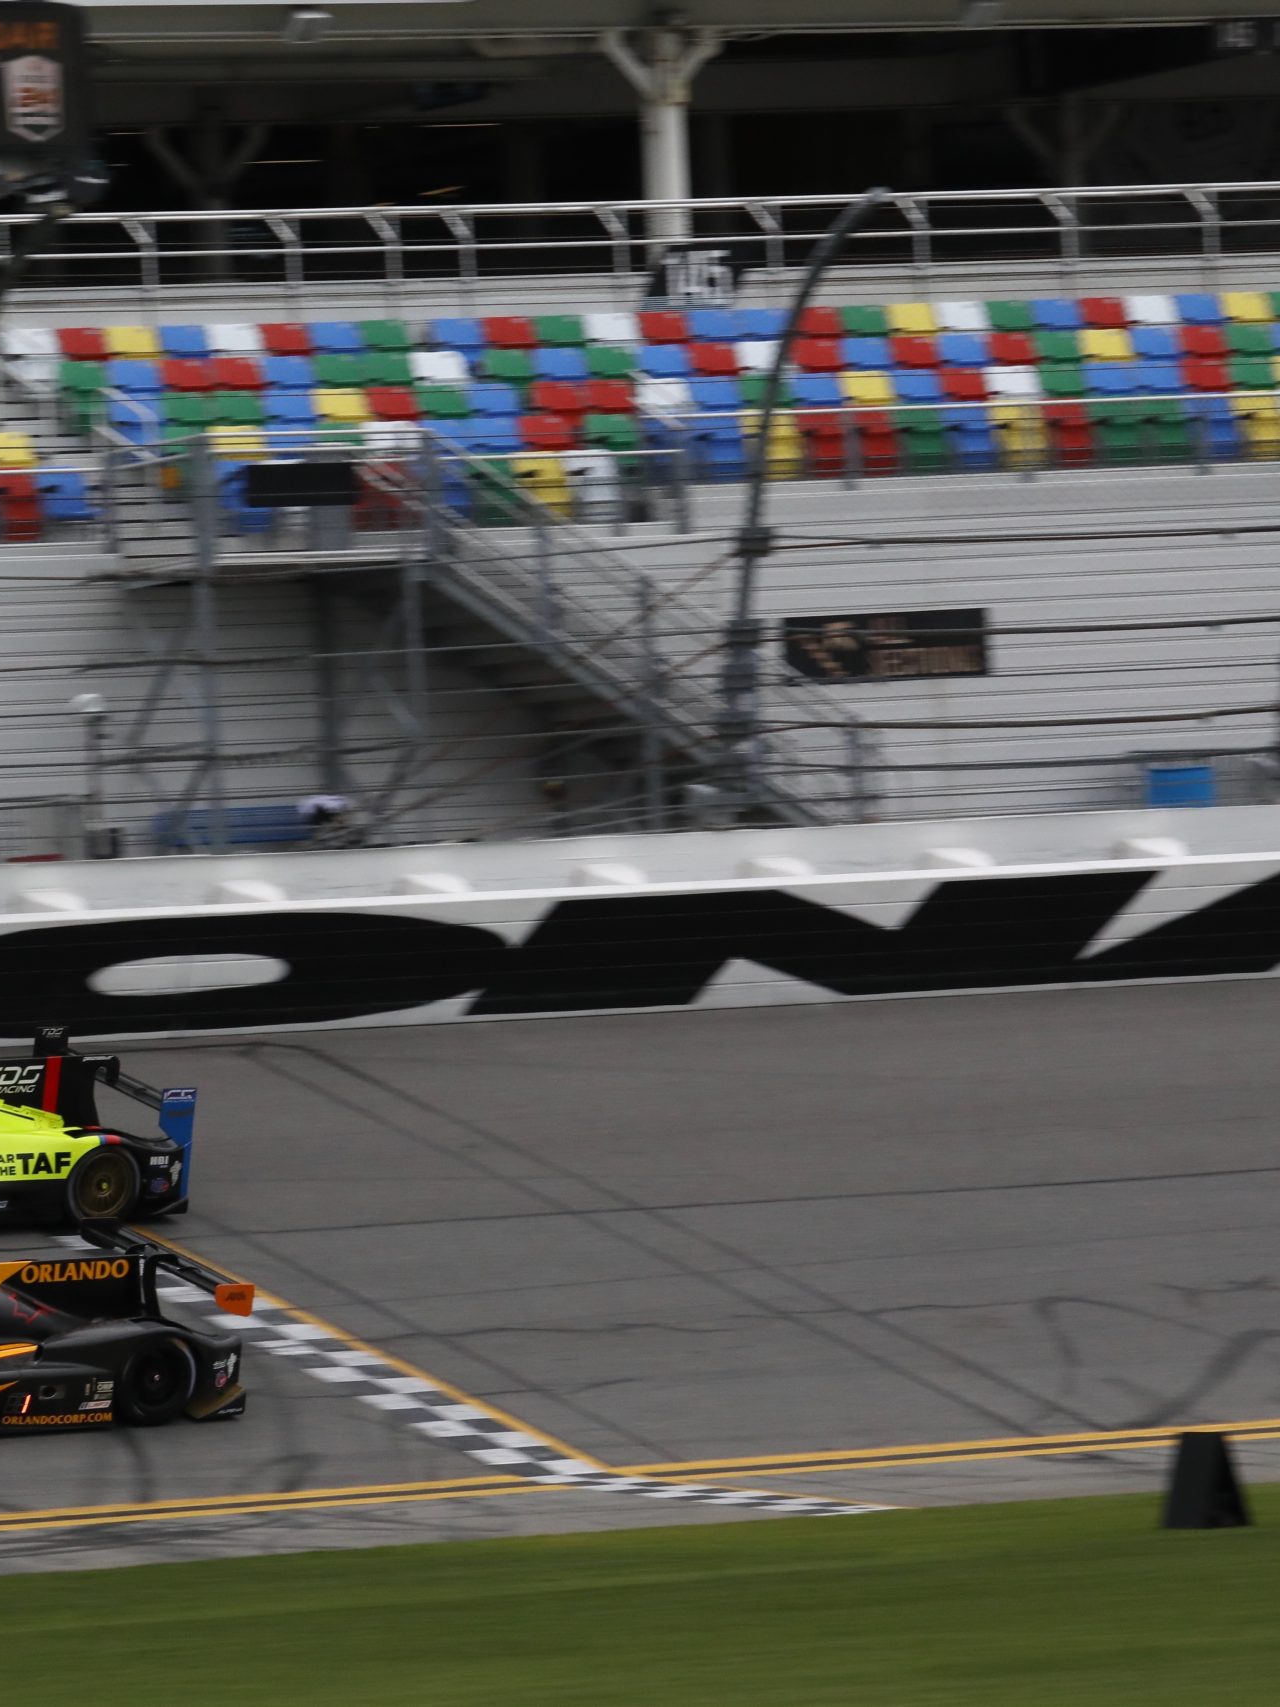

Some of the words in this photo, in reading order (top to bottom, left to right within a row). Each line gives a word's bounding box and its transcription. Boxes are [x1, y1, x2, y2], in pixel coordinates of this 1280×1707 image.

[16, 1152, 71, 1175] TAF
[149, 1155, 169, 1166] HBI
[21, 1259, 129, 1284] ORLANDO
[1, 1412, 113, 1425] ORLANDOCORP.COM
